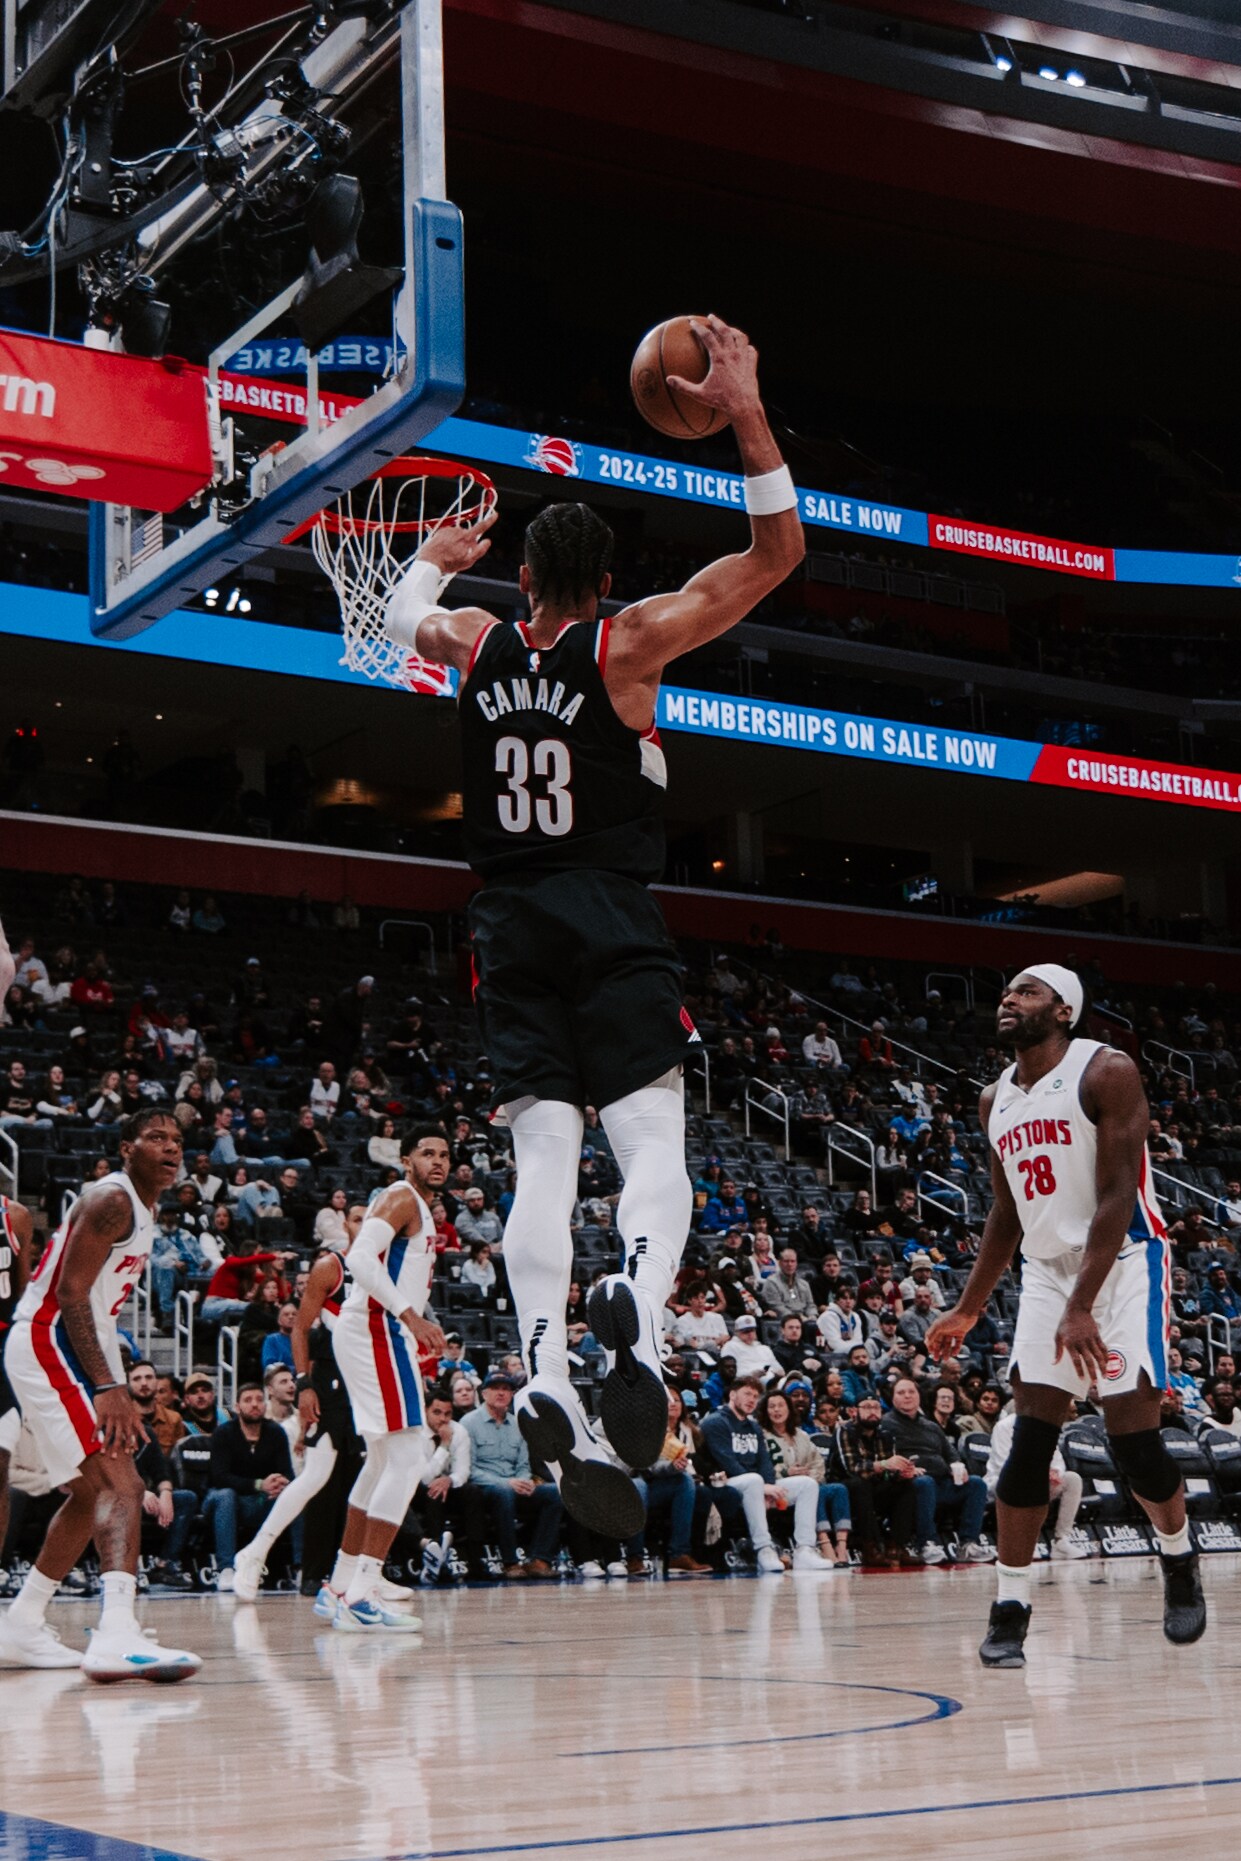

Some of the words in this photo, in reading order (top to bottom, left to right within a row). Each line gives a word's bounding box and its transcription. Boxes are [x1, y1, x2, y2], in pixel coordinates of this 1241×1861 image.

[599, 454, 678, 491] 2024-25
[804, 495, 852, 525] SALE
[858, 506, 902, 535] NOW
[935, 524, 1105, 572] CRUISEBASKETBALL.COM
[476, 678, 585, 726] CAMARA
[665, 693, 837, 746] MEMBERSHIPS
[844, 721, 875, 752] ON
[882, 727, 938, 761] SALE
[945, 736, 997, 769] NOW
[495, 736, 574, 837] 33
[997, 1119, 1072, 1163] PISTONS
[1017, 1154, 1057, 1201] 28
